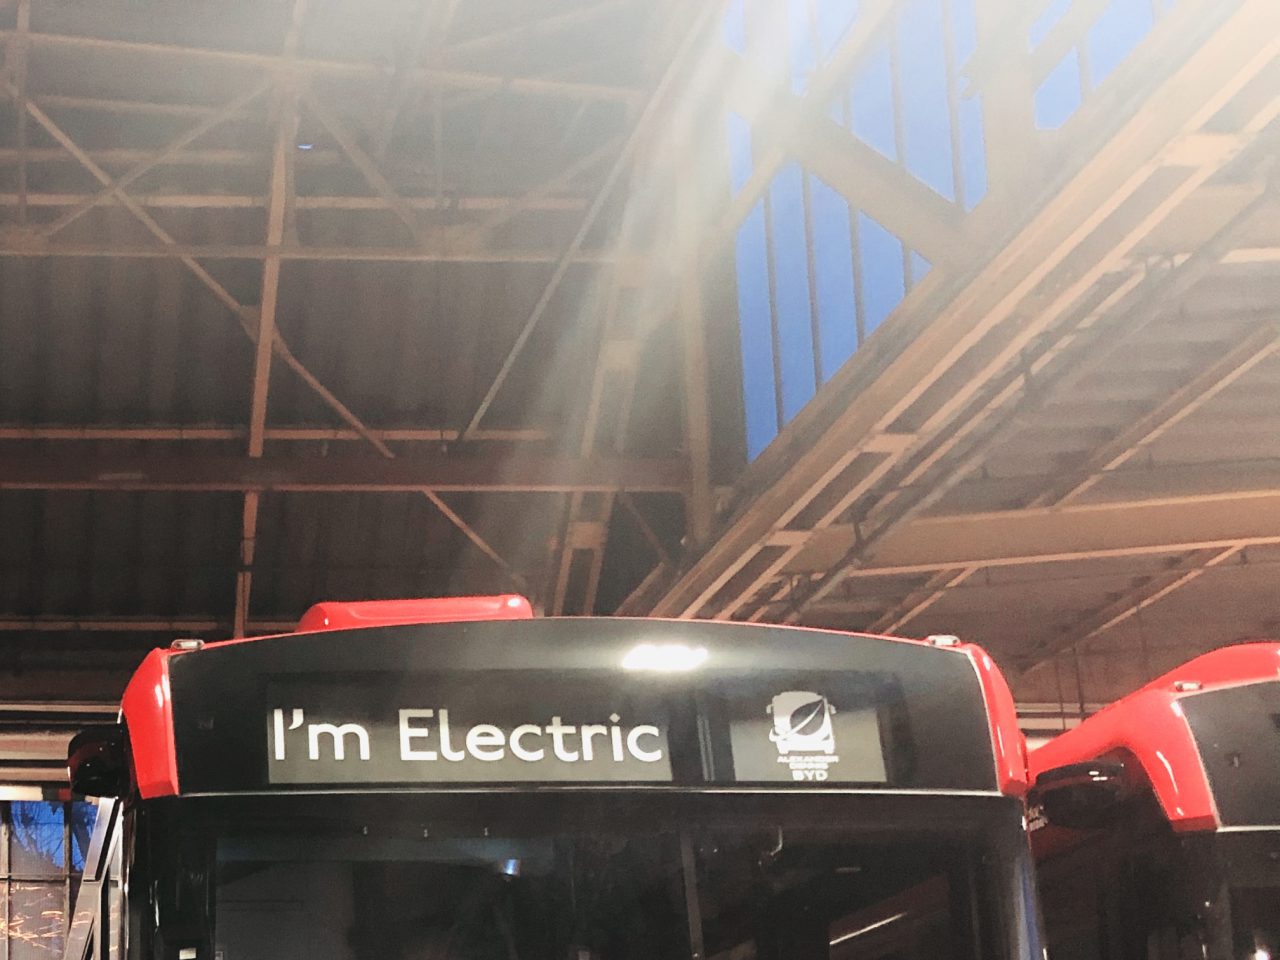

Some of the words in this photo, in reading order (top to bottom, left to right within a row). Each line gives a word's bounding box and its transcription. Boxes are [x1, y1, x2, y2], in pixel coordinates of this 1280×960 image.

[273, 708, 370, 761] I'm
[399, 708, 662, 762] Electric
[792, 769, 828, 781] BYD
